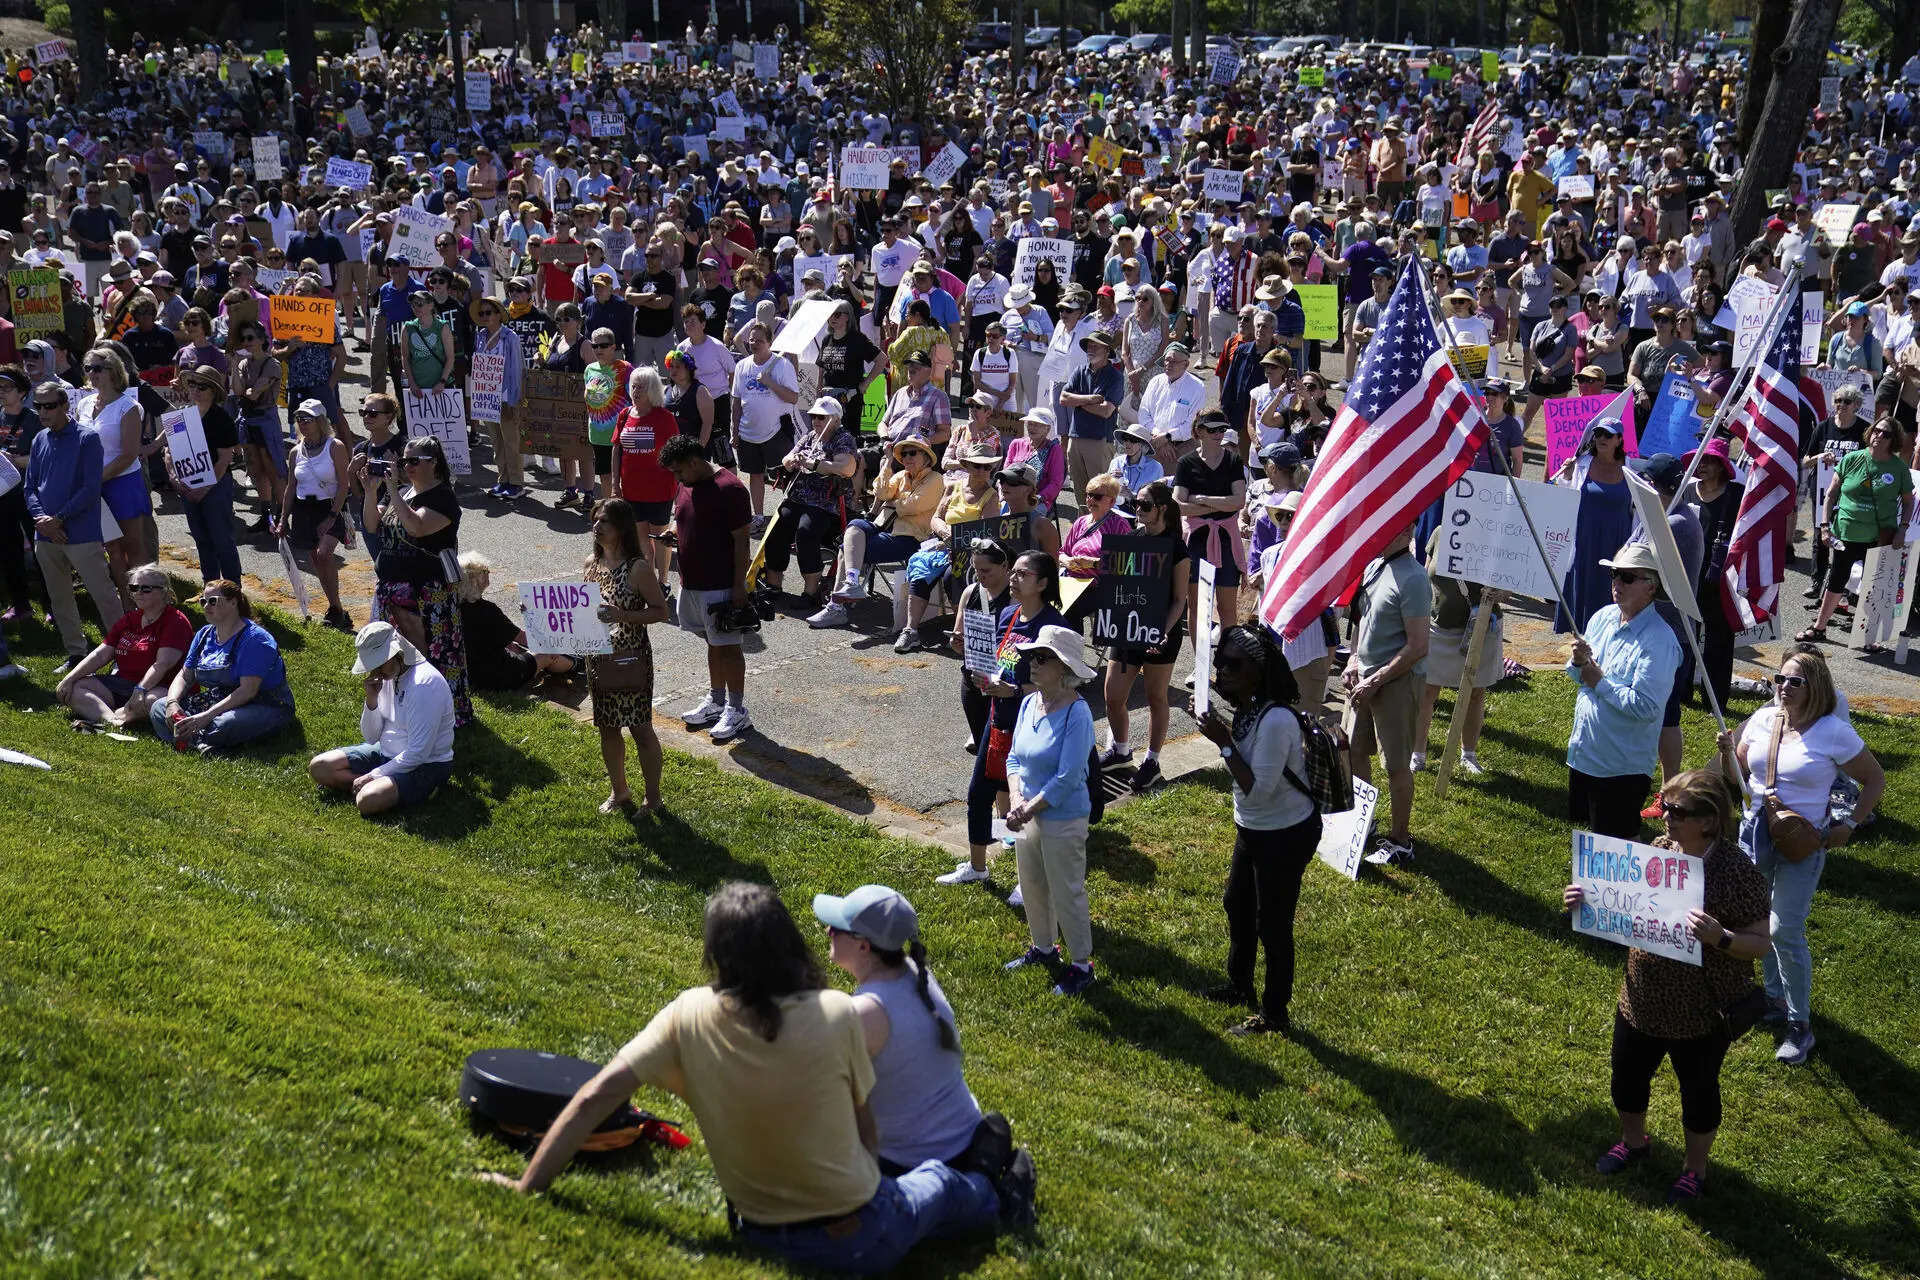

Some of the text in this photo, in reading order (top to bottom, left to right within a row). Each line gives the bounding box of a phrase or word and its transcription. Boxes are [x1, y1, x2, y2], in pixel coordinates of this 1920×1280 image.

[399, 242, 434, 263] PUBLIC
[273, 298, 332, 316] HANDS OFF
[273, 317, 324, 338] Democracy
[407, 389, 463, 420] HANDS
[1547, 398, 1602, 419] DEFEND
[412, 420, 458, 440] OFF
[174, 451, 211, 479] RESIST
[999, 516, 1028, 540] OFF
[1102, 551, 1168, 578] EQUALITY
[532, 584, 591, 610] HANDS
[1114, 584, 1148, 606] Hurts
[547, 611, 574, 634] OFF
[1096, 608, 1161, 645] No One
[1578, 833, 1690, 891] Hands OFF
[1579, 902, 1698, 954] DEMOCRACY
